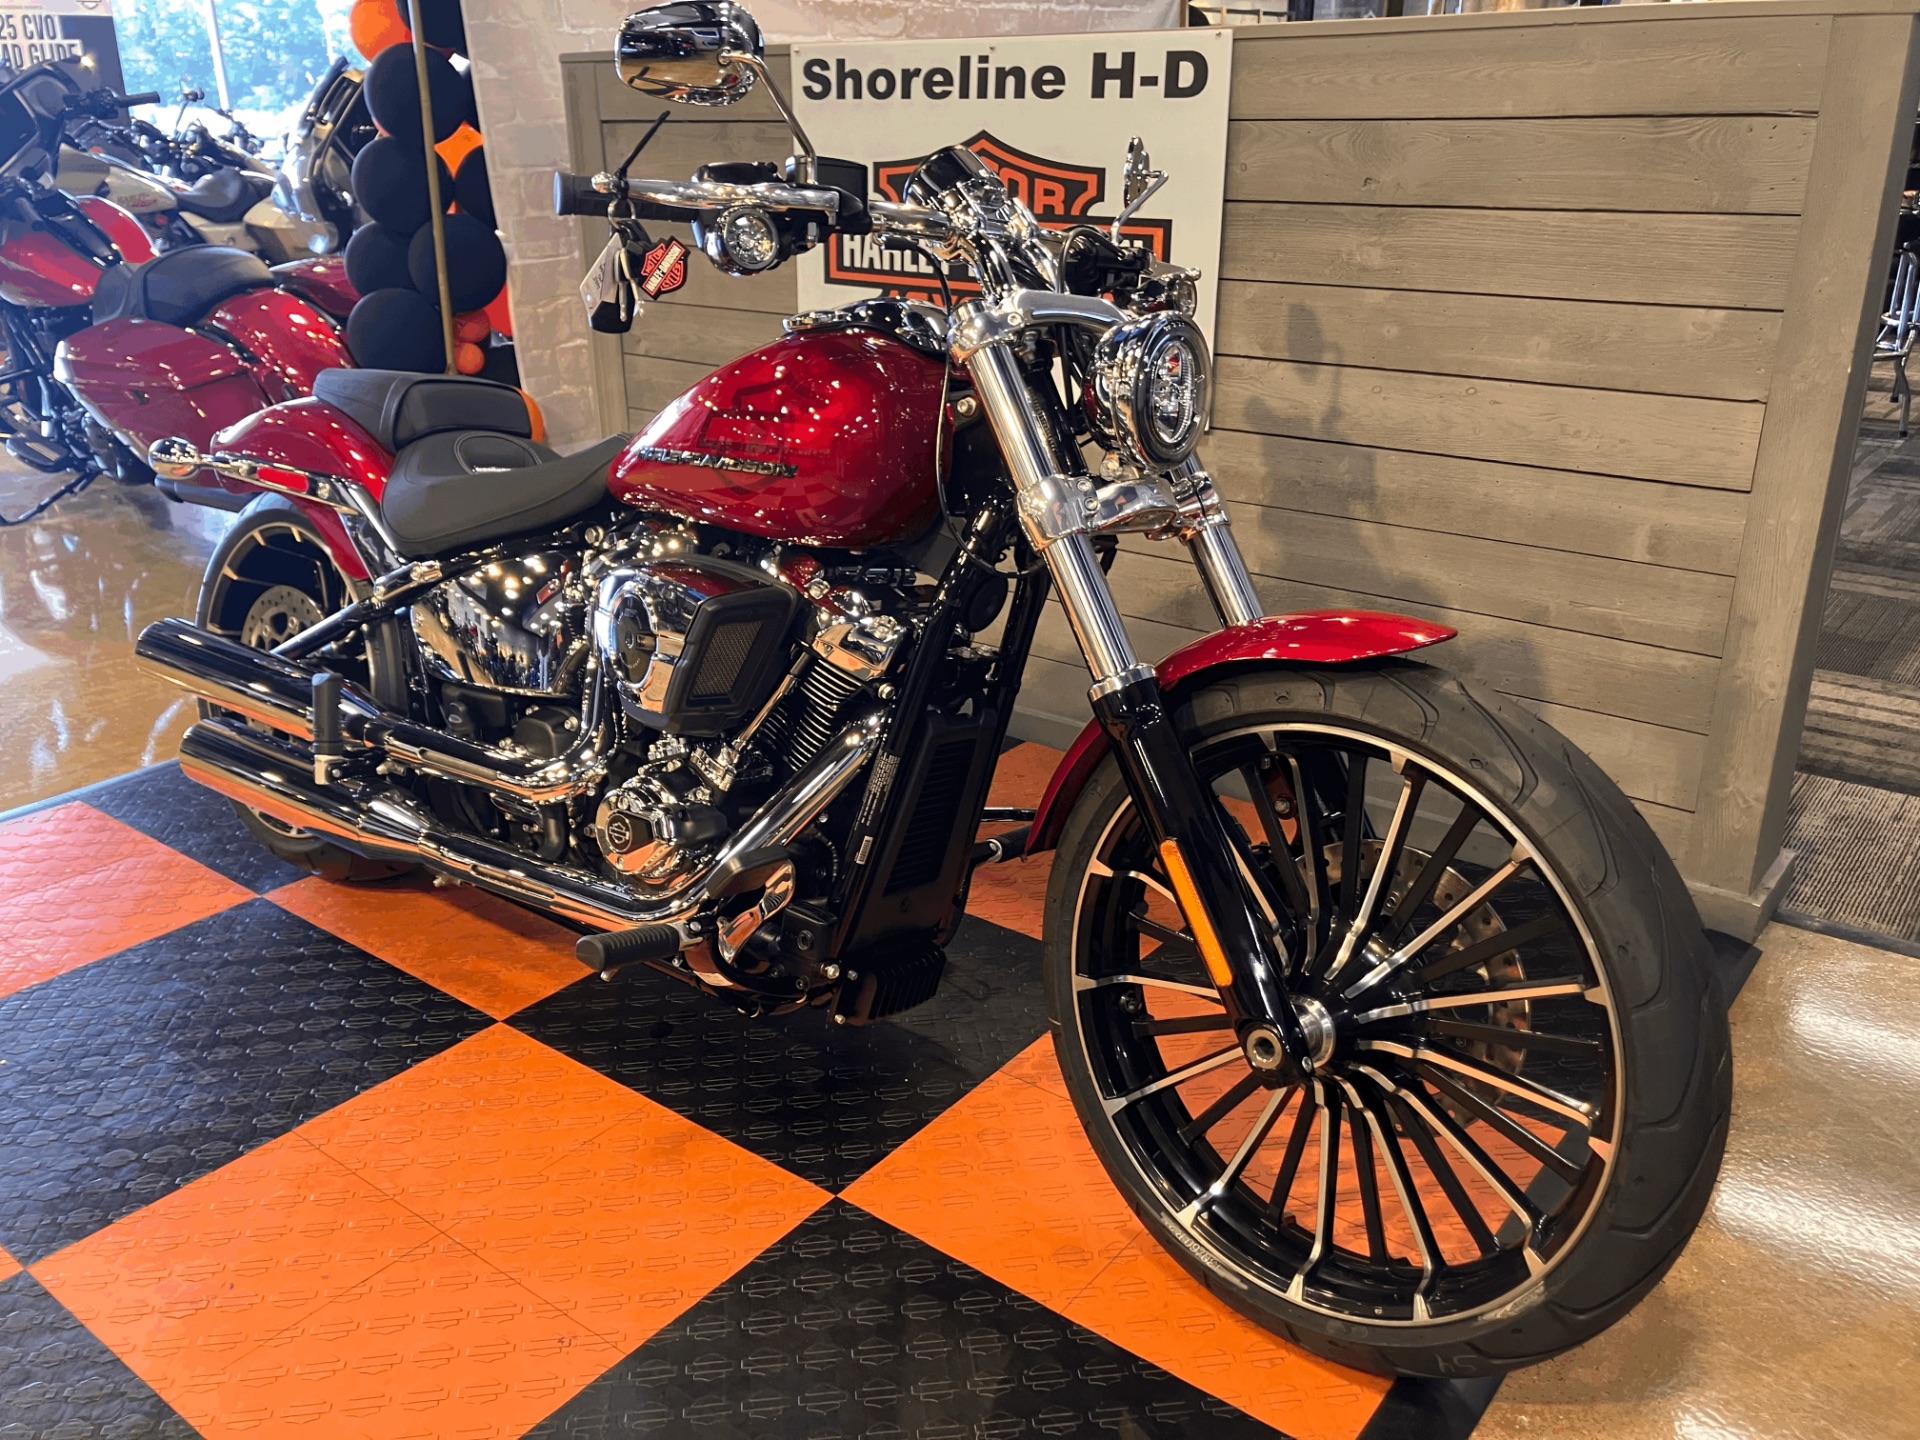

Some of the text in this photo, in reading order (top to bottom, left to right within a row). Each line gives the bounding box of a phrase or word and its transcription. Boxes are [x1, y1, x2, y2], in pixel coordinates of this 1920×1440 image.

[22, 14, 56, 40] CVO
[802, 50, 1209, 100] Shoreline H-D
[645, 249, 665, 274] MOTOR
[645, 244, 682, 292] HARLEY-DAVIDSON
